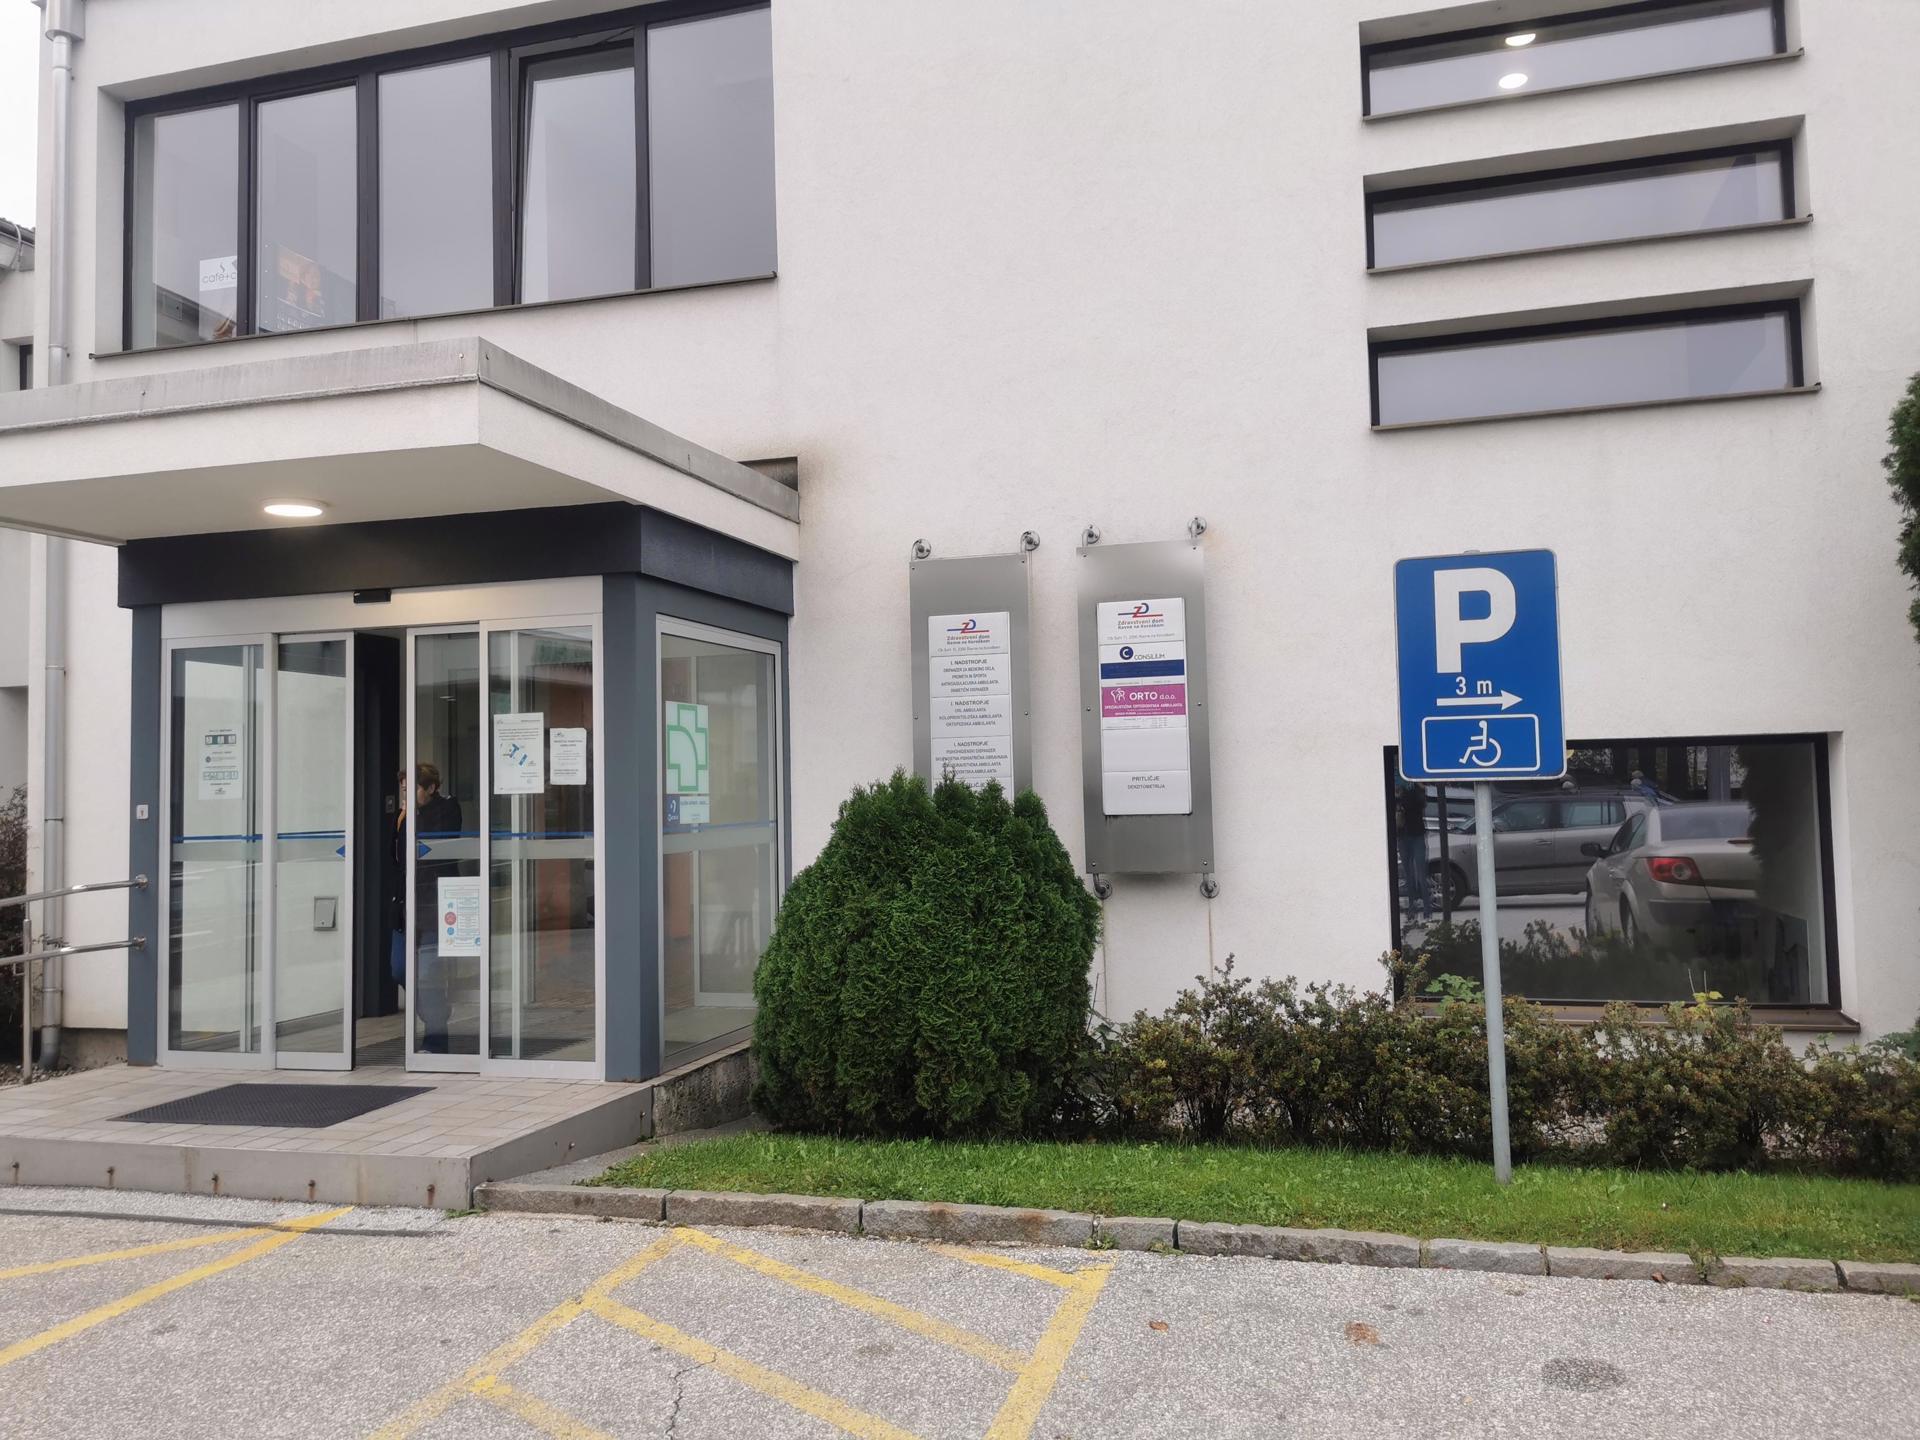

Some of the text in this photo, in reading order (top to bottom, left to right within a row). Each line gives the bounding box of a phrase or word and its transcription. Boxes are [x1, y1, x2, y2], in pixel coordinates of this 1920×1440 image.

[1433, 567, 1516, 674] P
[1129, 691, 1158, 701] ORTO
[1455, 676, 1493, 696] 3 m
